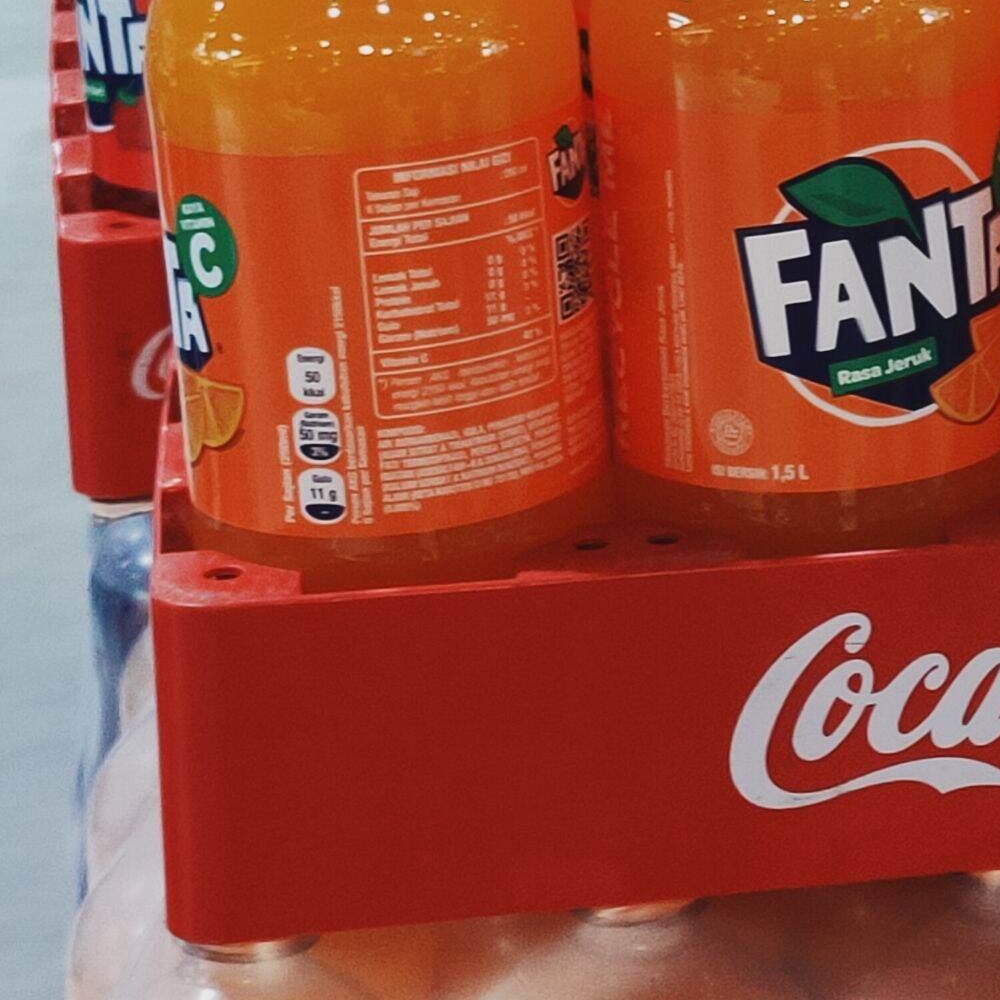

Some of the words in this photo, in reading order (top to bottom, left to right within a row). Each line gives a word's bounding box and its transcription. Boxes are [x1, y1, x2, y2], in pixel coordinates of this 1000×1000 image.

[189, 231, 224, 289] C
[837, 365, 882, 386] Rasa
[884, 347, 933, 375] Jeruk
[305, 371, 321, 383] 50
[770, 464, 796, 483] 1,5
[797, 464, 810, 480] L
[310, 488, 324, 500] 11
[329, 489, 338, 502] g
